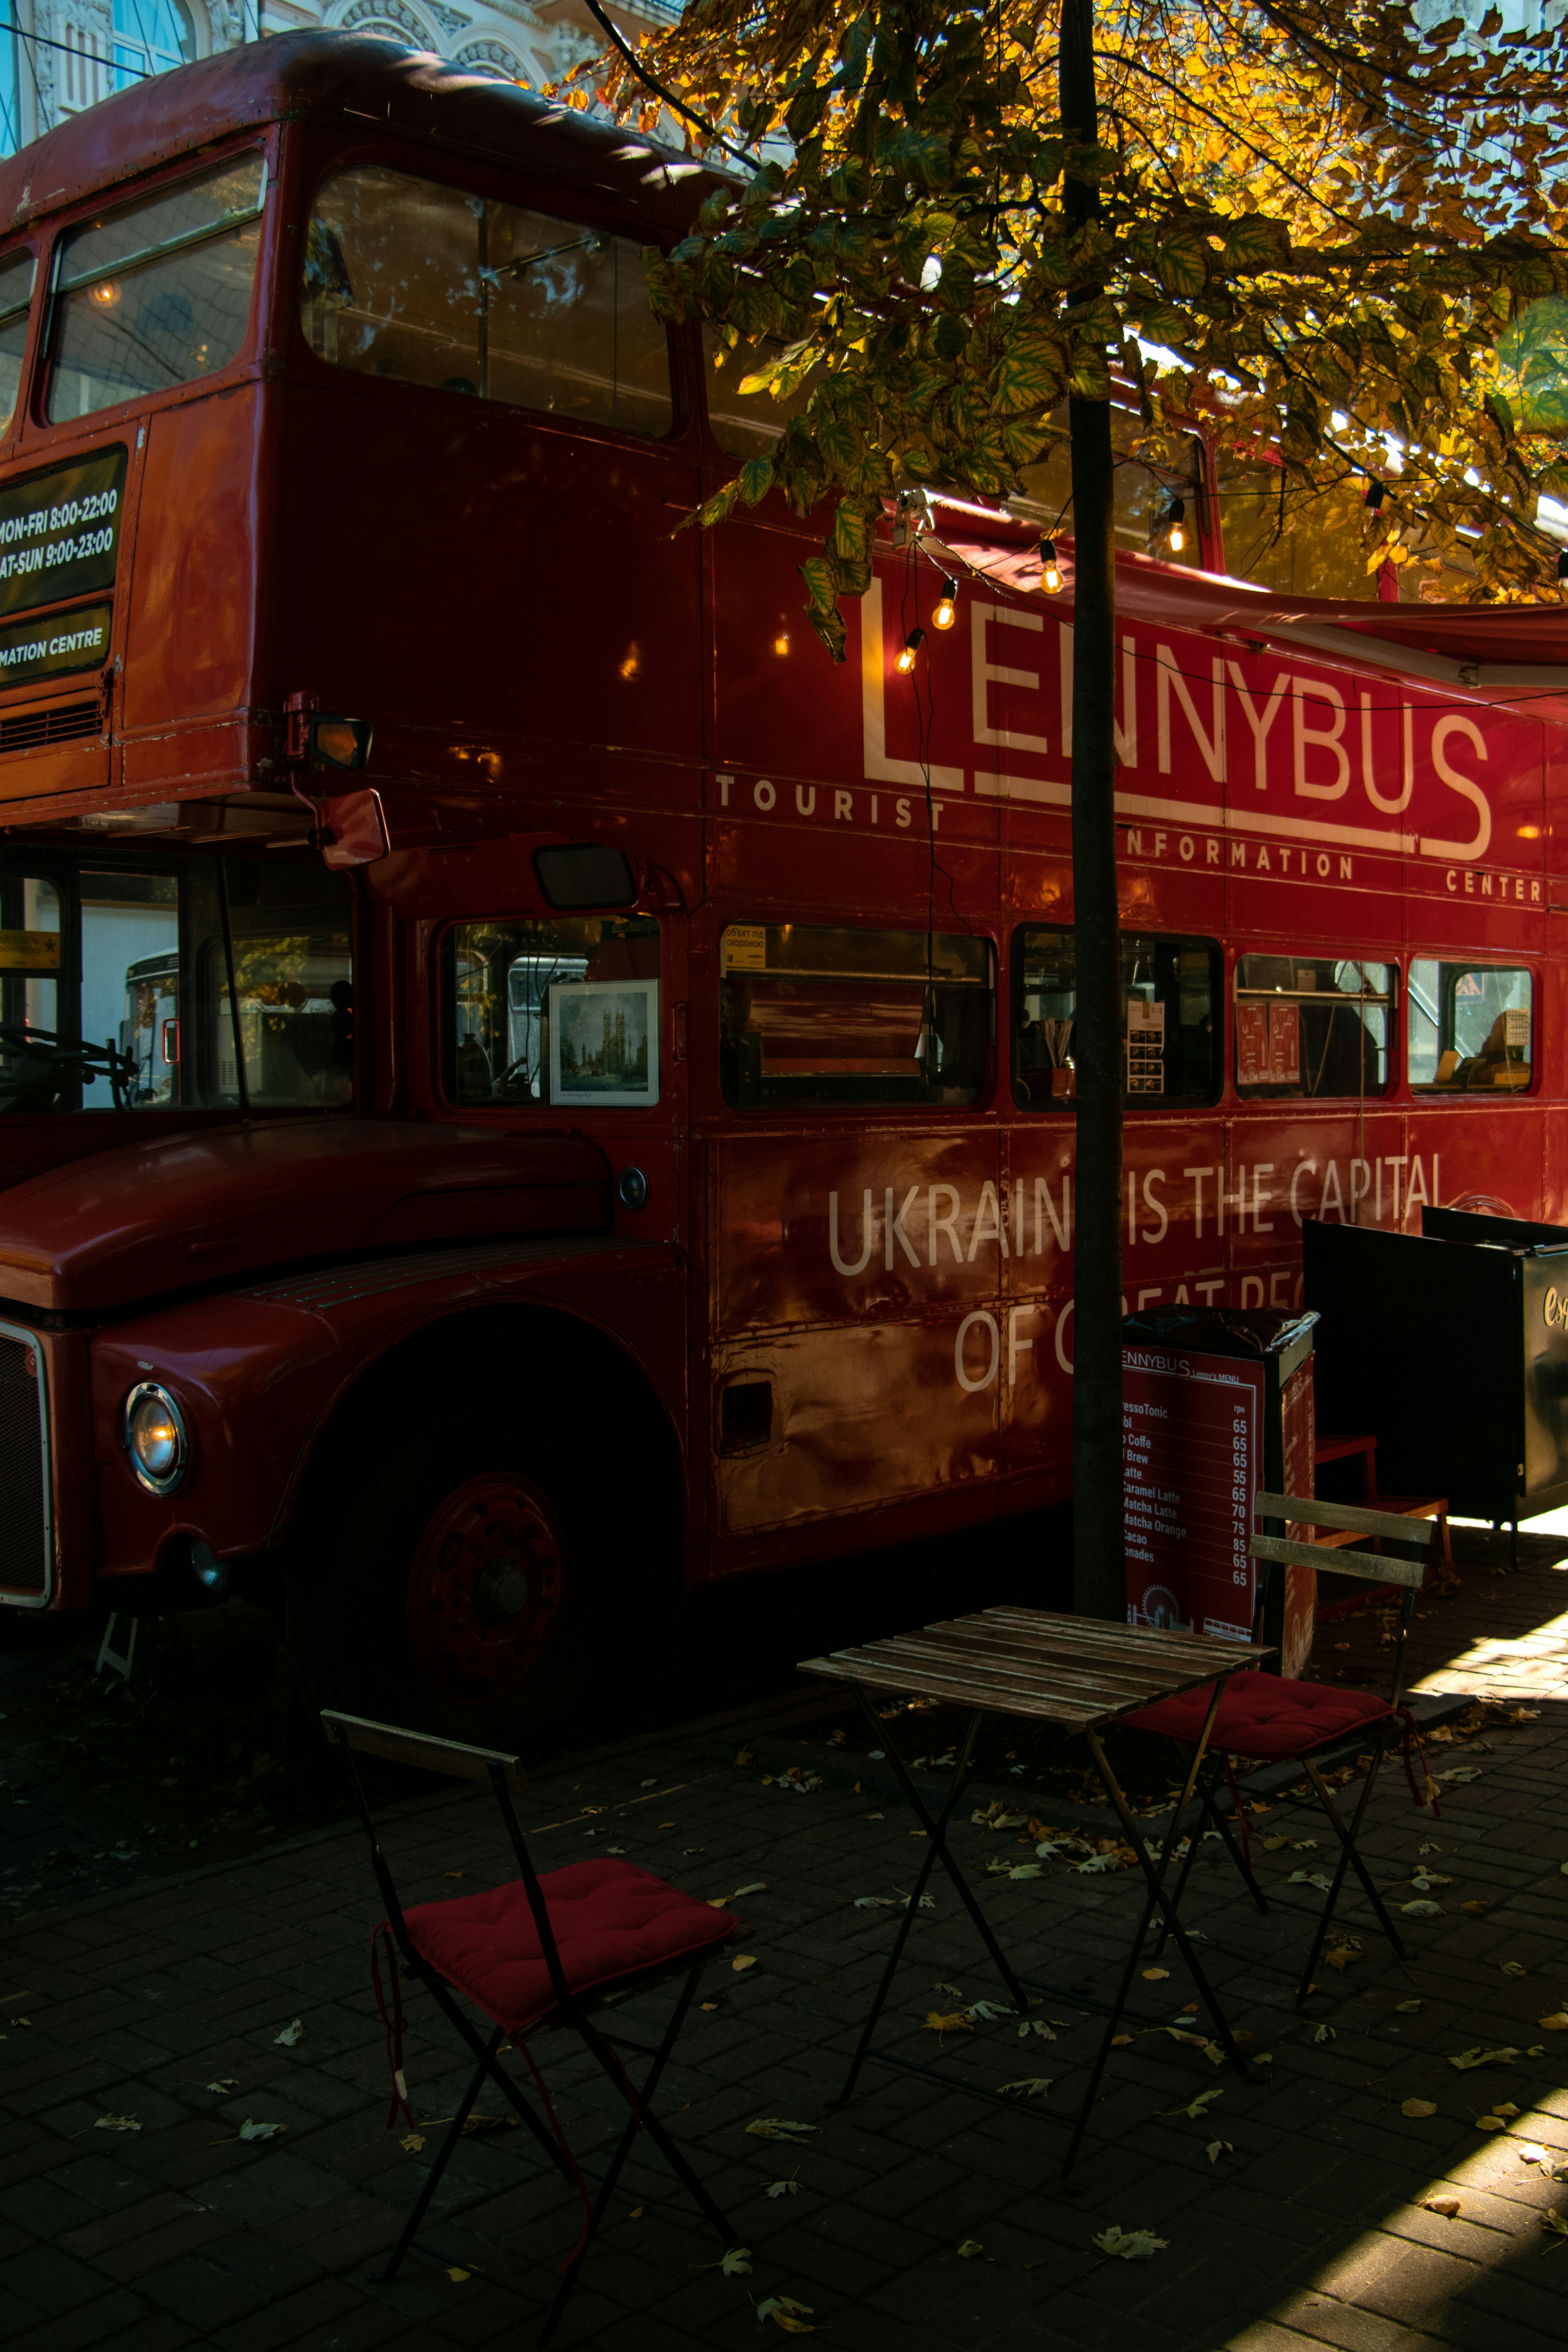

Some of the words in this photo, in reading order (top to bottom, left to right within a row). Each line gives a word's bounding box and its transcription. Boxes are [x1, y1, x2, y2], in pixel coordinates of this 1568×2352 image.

[50, 488, 118, 531] 8:00-22:00
[45, 526, 113, 568] 9:00-23:00
[49, 627, 103, 655] CENTRE
[715, 775, 944, 832] TOURIST
[1126, 828, 1353, 880] NFORMATION
[1446, 871, 1541, 902] CENTER
[726, 939, 764, 948] охороною
[752, 929, 764, 939] під
[829, 1175, 1071, 1276] UKRAIN
[1128, 1169, 1169, 1246] IS
[1183, 1163, 1275, 1239] THE
[954, 1305, 1035, 1393] OF
[1218, 1373, 1239, 1383] MENU
[1122, 1402, 1168, 1419] essoTonic
[1233, 1419, 1247, 1434] 65
[1234, 1405, 1245, 1414] грн
[1122, 1416, 1132, 1429] bl
[1233, 1436, 1247, 1452] 65
[1127, 1449, 1149, 1465] Brew
[1233, 1469, 1246, 1485] 55
[1128, 1434, 1151, 1449] Coffe
[1233, 1452, 1247, 1468] 65
[1123, 1467, 1142, 1480] atte
[1232, 1486, 1246, 1502] 65
[1154, 1503, 1177, 1519] Latte
[1232, 1521, 1245, 1535] 75
[1158, 1488, 1180, 1504] Latte
[1232, 1504, 1245, 1518] 70
[1154, 1520, 1187, 1539] Orange
[1233, 1538, 1246, 1552] 85
[1233, 1554, 1247, 1569] 65
[1233, 1570, 1247, 1586] 65
